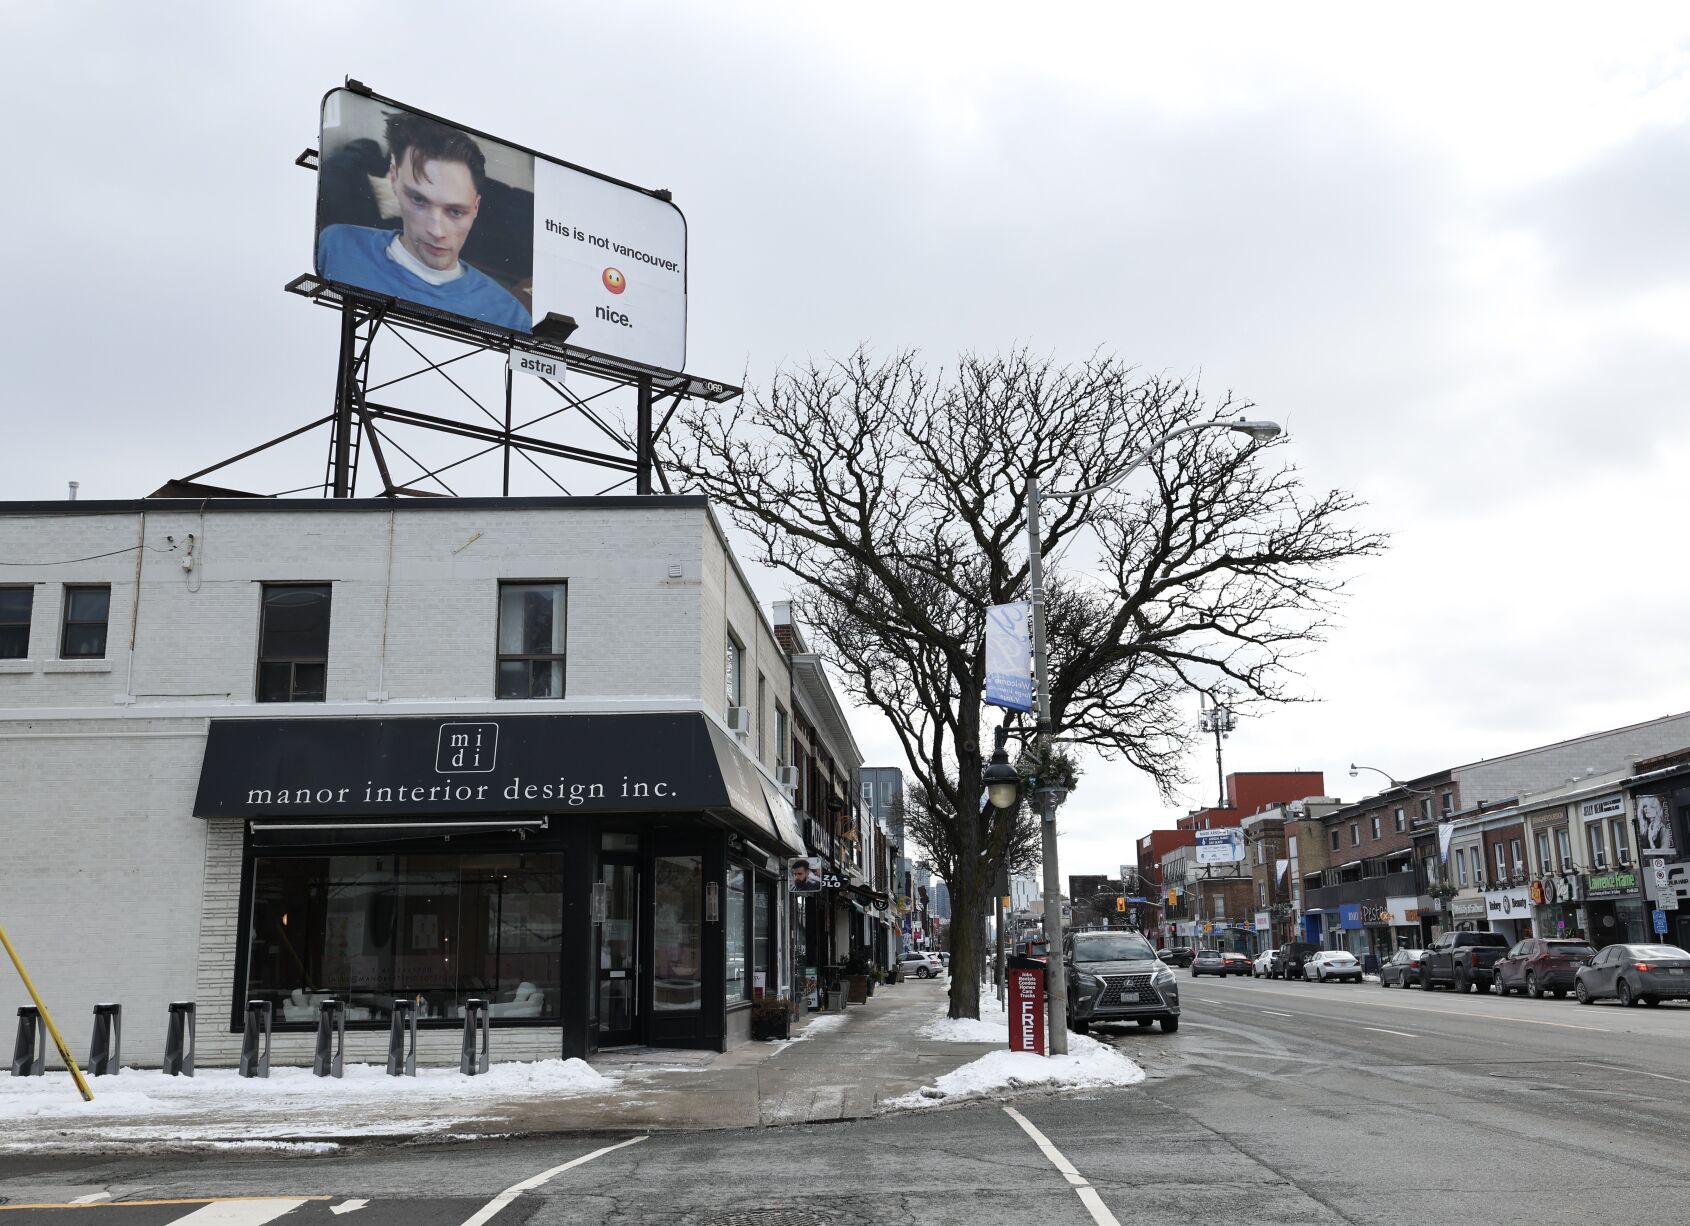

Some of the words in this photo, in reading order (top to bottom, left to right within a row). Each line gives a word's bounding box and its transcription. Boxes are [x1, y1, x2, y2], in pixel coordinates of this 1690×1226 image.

[545, 219, 570, 237] this
[573, 227, 585, 242] is
[588, 234, 610, 250] not
[612, 242, 680, 273] vancouver.
[595, 305, 633, 328] nice.
[520, 357, 556, 376] astral
[246, 788, 350, 804] manor
[362, 779, 489, 802] interior
[503, 777, 605, 806] design
[620, 775, 677, 798] inc.
[1588, 874, 1615, 890] Lawrence
[1615, 872, 1635, 887] Frame
[1021, 1001, 1035, 1050] FREE
